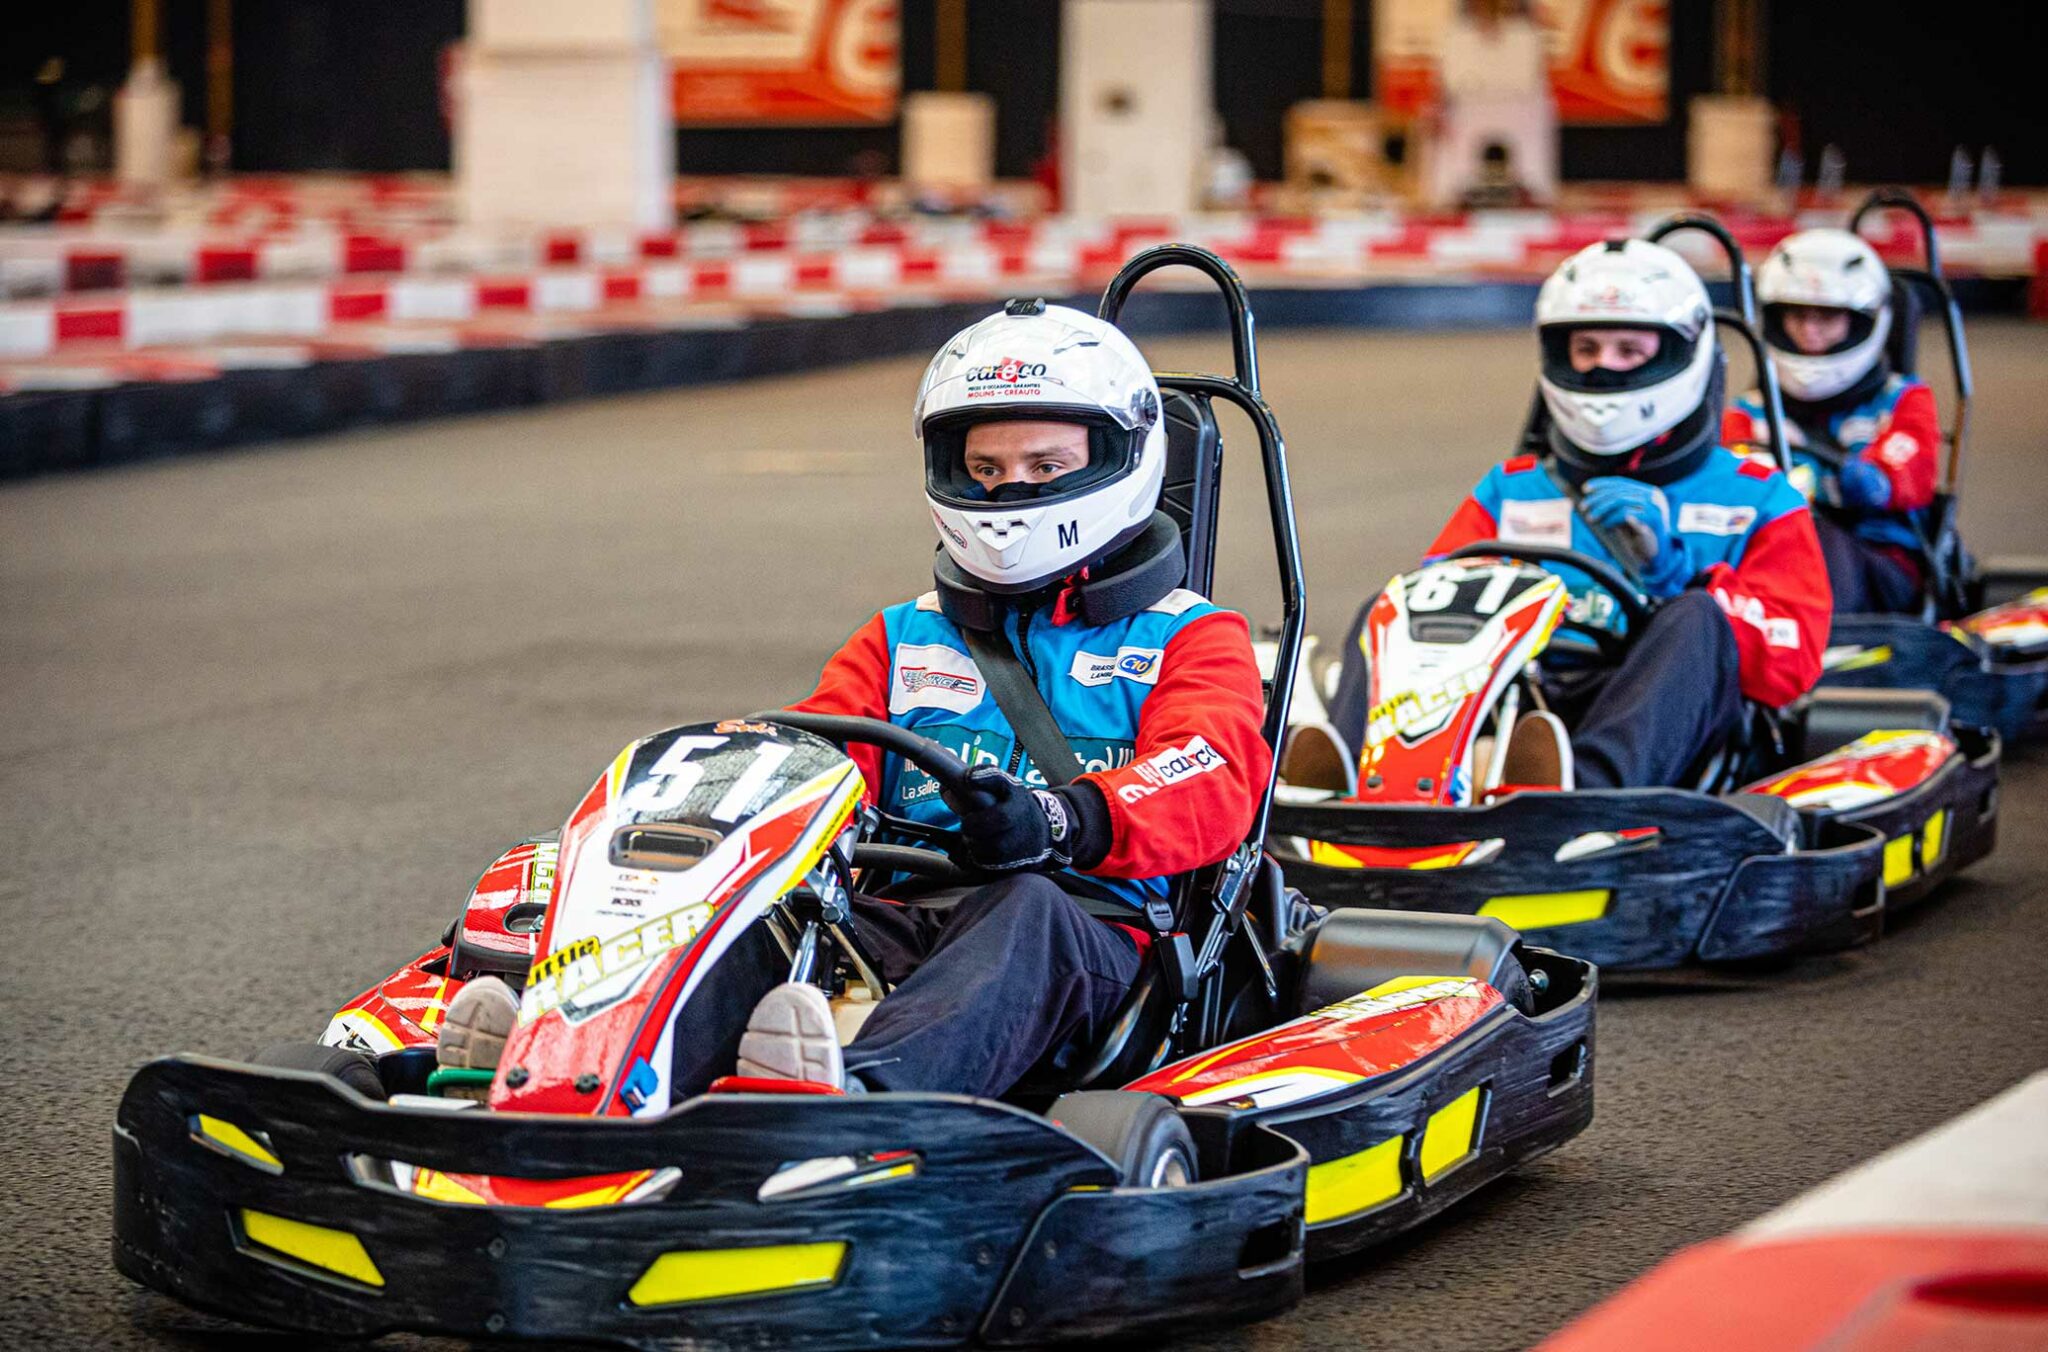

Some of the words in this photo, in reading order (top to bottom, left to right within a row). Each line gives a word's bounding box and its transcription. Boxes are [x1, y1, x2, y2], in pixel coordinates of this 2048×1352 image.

[967, 389, 995, 398] MOLINS
[1057, 519, 1080, 549] M
[620, 735, 796, 824] 51
[902, 785, 916, 799] La
[917, 779, 940, 798] salle
[517, 900, 716, 1030] RACER
